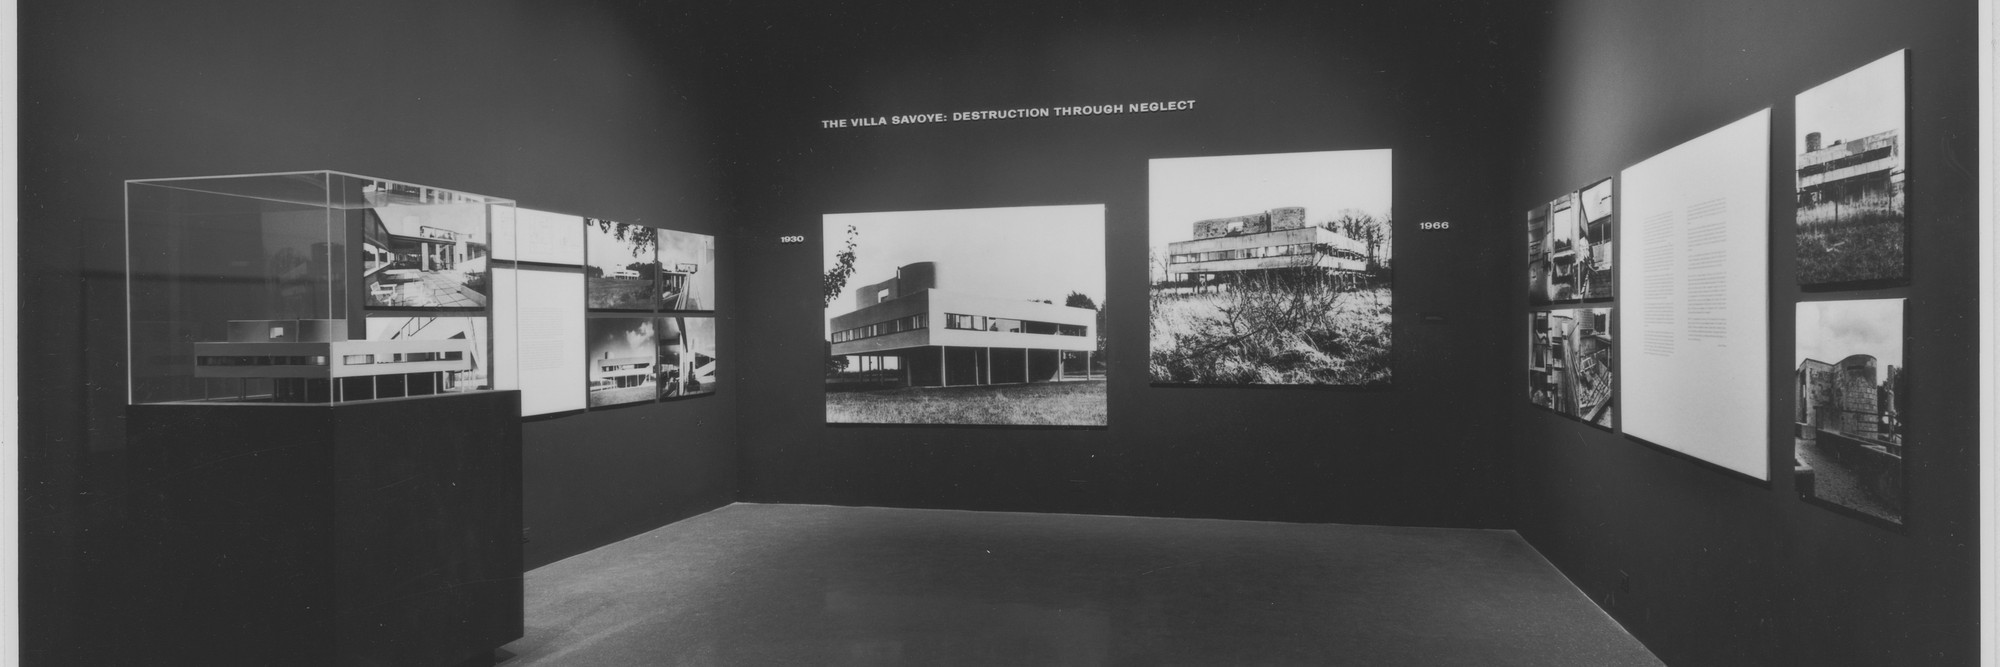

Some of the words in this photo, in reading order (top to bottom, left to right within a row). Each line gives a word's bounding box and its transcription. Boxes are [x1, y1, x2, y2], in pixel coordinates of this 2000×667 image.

[821, 119, 847, 129] THE
[850, 116, 887, 128] VILLA
[891, 113, 948, 126] SAVOYE:
[952, 107, 1050, 122] DESTRUCTION
[1053, 103, 1124, 117] THROUGH
[1129, 99, 1196, 113] NEGLECT
[1419, 221, 1449, 230] 1966
[780, 235, 805, 243] 1930
